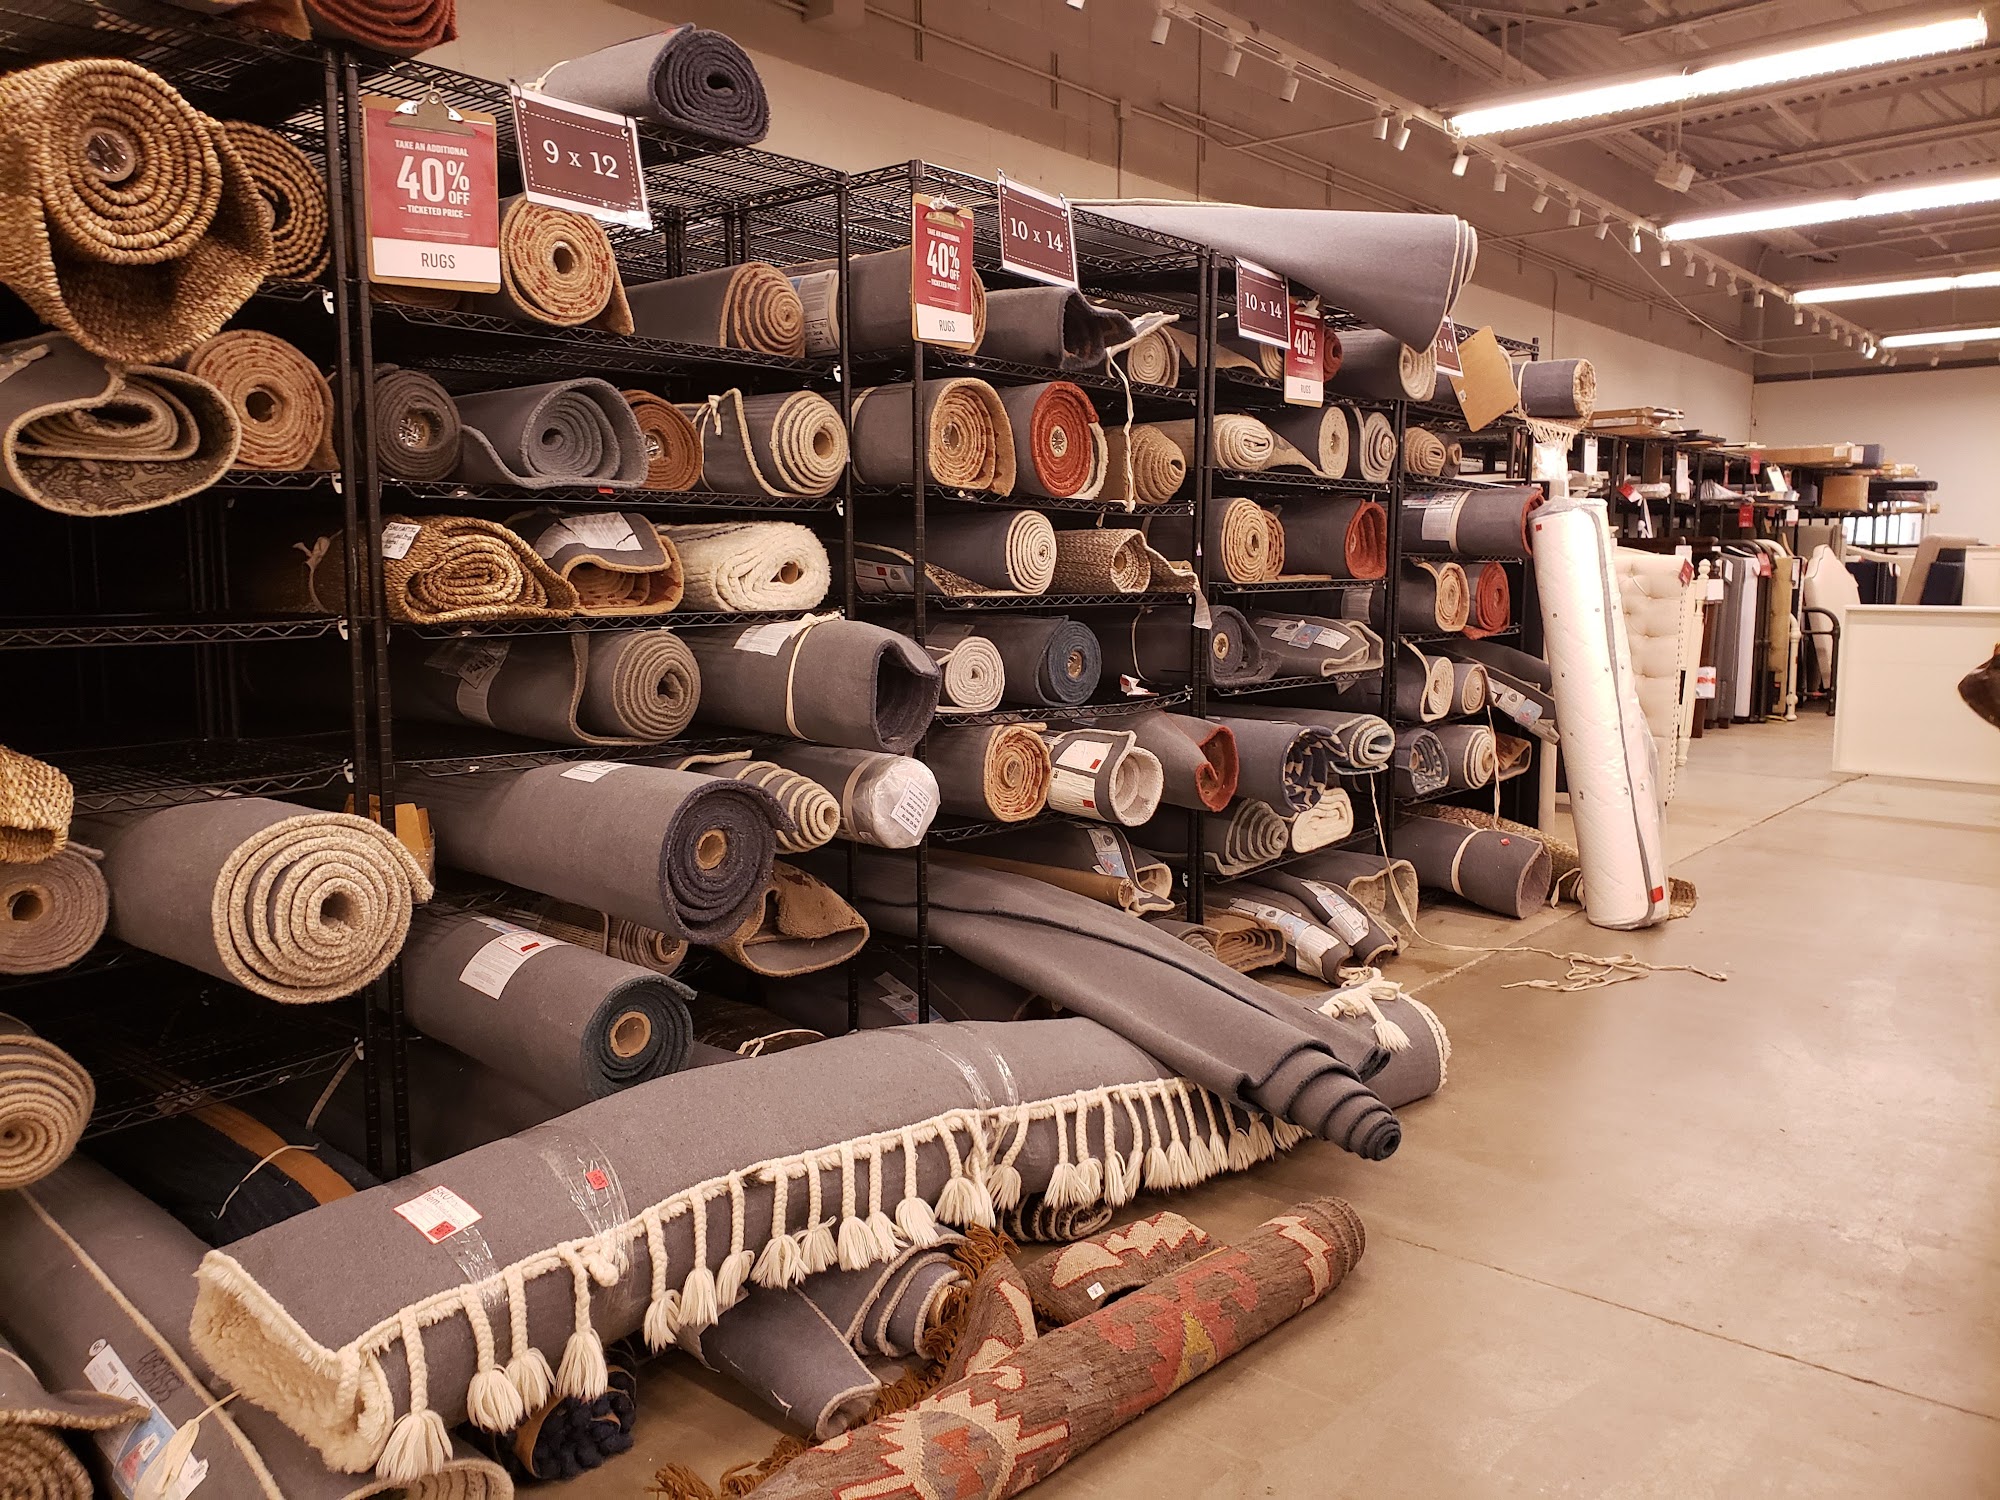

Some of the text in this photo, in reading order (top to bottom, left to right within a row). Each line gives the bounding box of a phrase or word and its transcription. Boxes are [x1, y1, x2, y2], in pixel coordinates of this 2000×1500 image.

[394, 139, 469, 157] TAKE AN ADDITIONAL
[542, 139, 620, 180] 9 x 12
[396, 155, 470, 203] 40%
[448, 190, 471, 206] OFF
[406, 204, 464, 219] TICKETED PRICE
[1010, 217, 1064, 253] 10 x 14
[421, 252, 456, 270] RUGS
[926, 240, 960, 278] 40%
[949, 268, 960, 281] OFF
[1244, 292, 1282, 319] 10 x 14
[938, 319, 956, 333] RUGS
[1294, 328, 1316, 356] 40%
